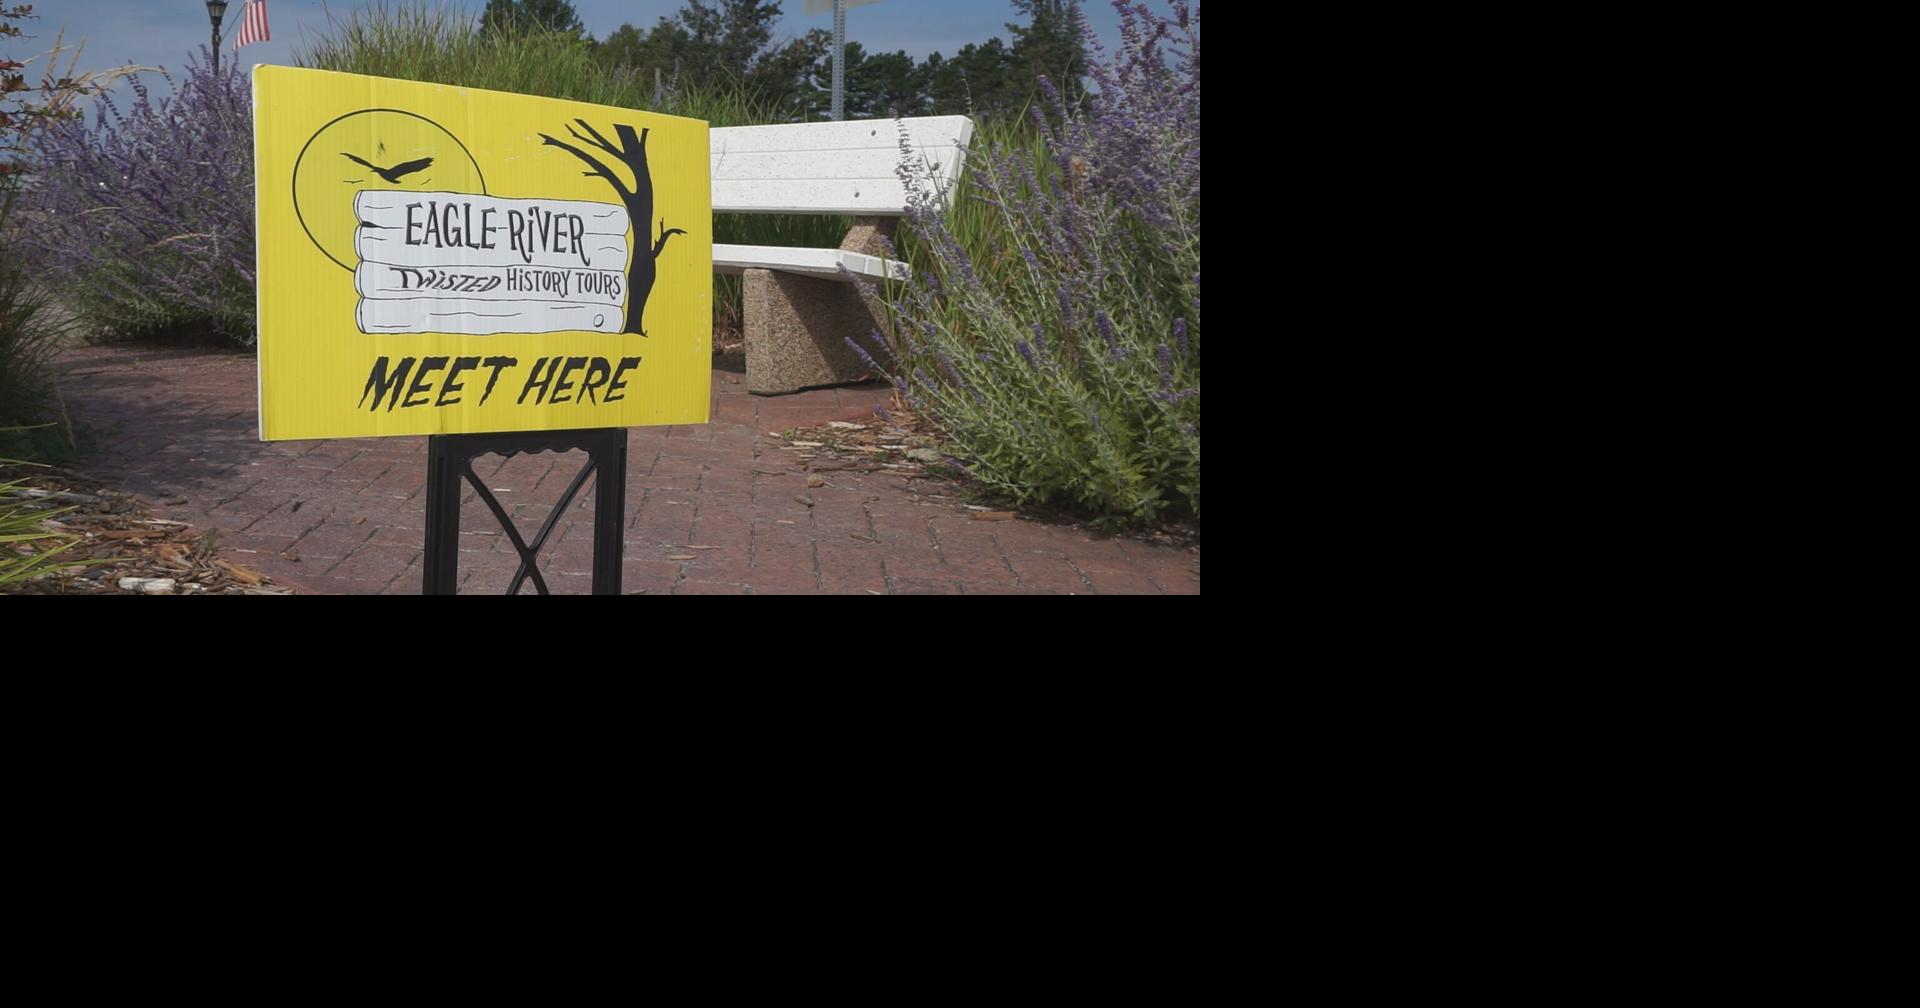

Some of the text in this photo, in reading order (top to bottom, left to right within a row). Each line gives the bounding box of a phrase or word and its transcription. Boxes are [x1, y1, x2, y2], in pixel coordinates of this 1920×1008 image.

[404, 201, 497, 250] EAGLE
[575, 271, 622, 300] TOURS
[358, 356, 642, 413] MEET HERE
